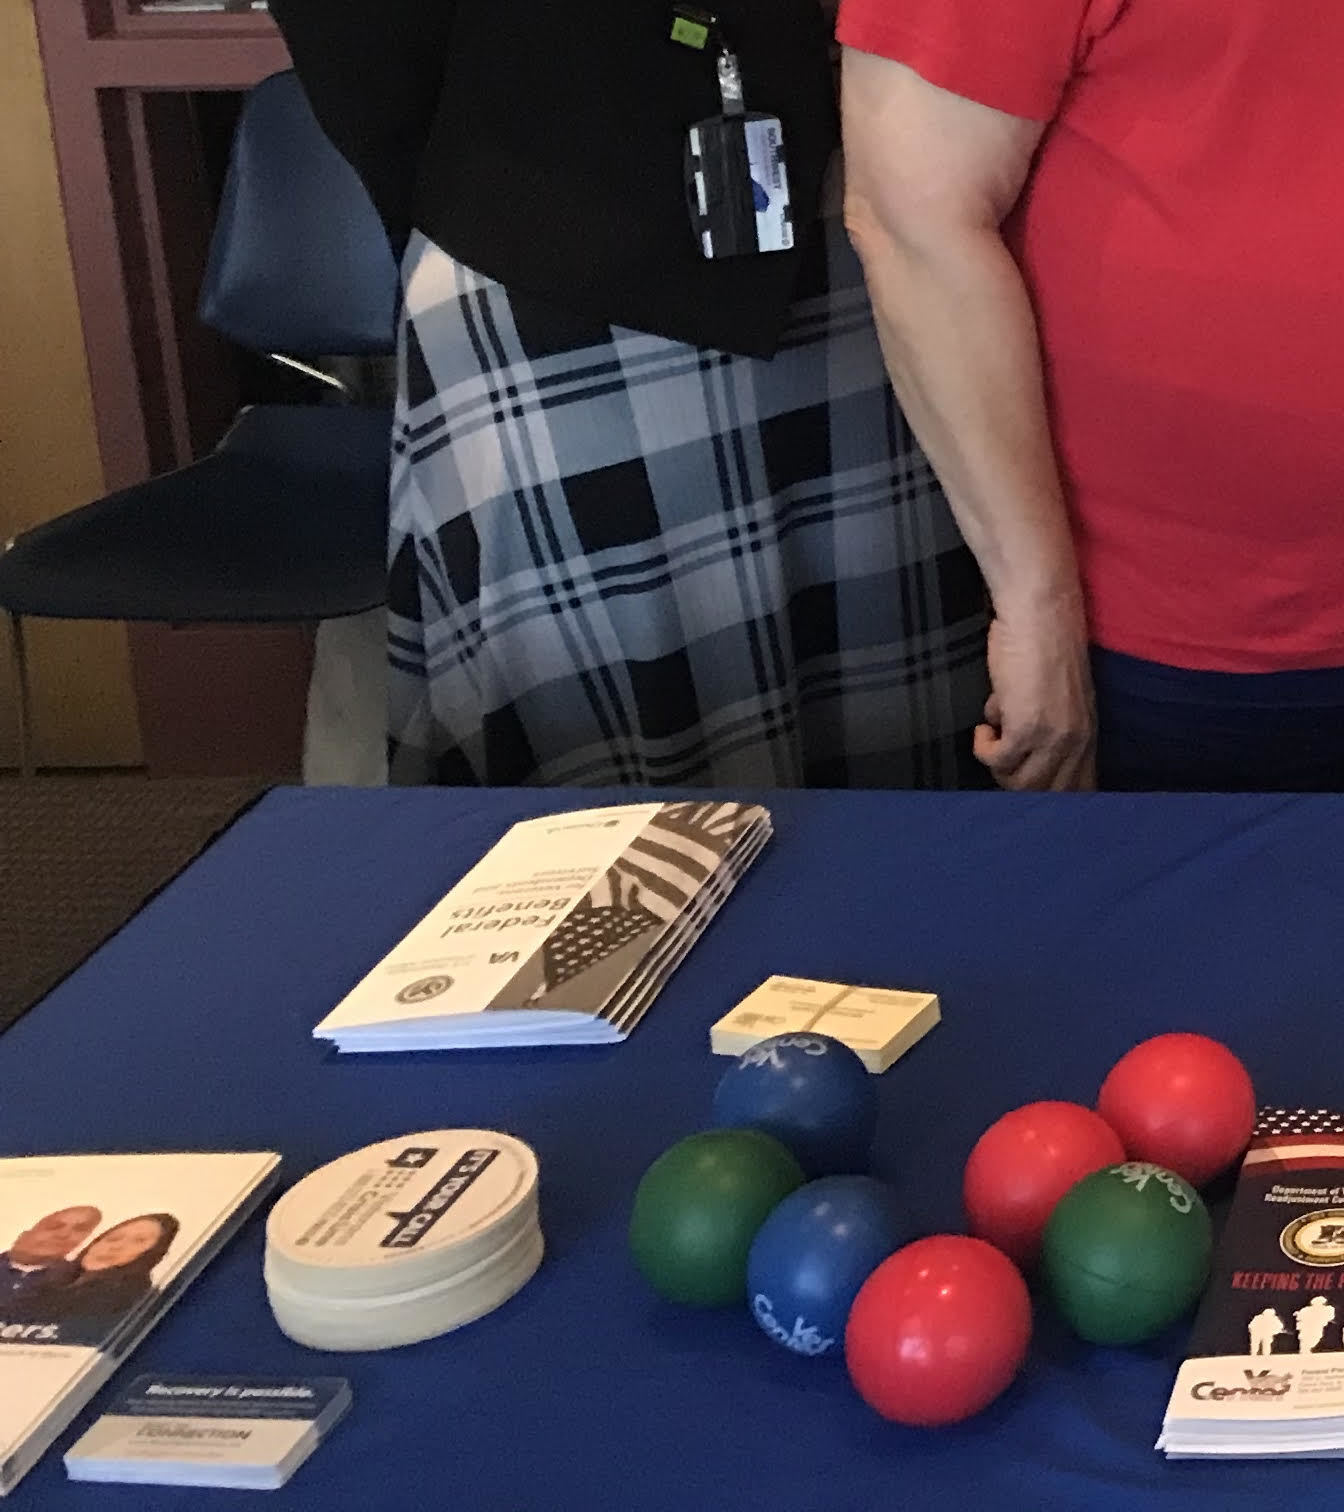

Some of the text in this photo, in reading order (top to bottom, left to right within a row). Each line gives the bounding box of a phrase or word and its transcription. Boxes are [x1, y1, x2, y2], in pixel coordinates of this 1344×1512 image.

[450, 896, 572, 921] Benefits
[440, 913, 557, 939] Federal
[488, 950, 522, 965] VA
[1232, 1271, 1299, 1290] KEEPING
[1305, 1271, 1335, 1290] THE
[0, 1321, 58, 1339] ers.
[1191, 1381, 1291, 1401] Center
